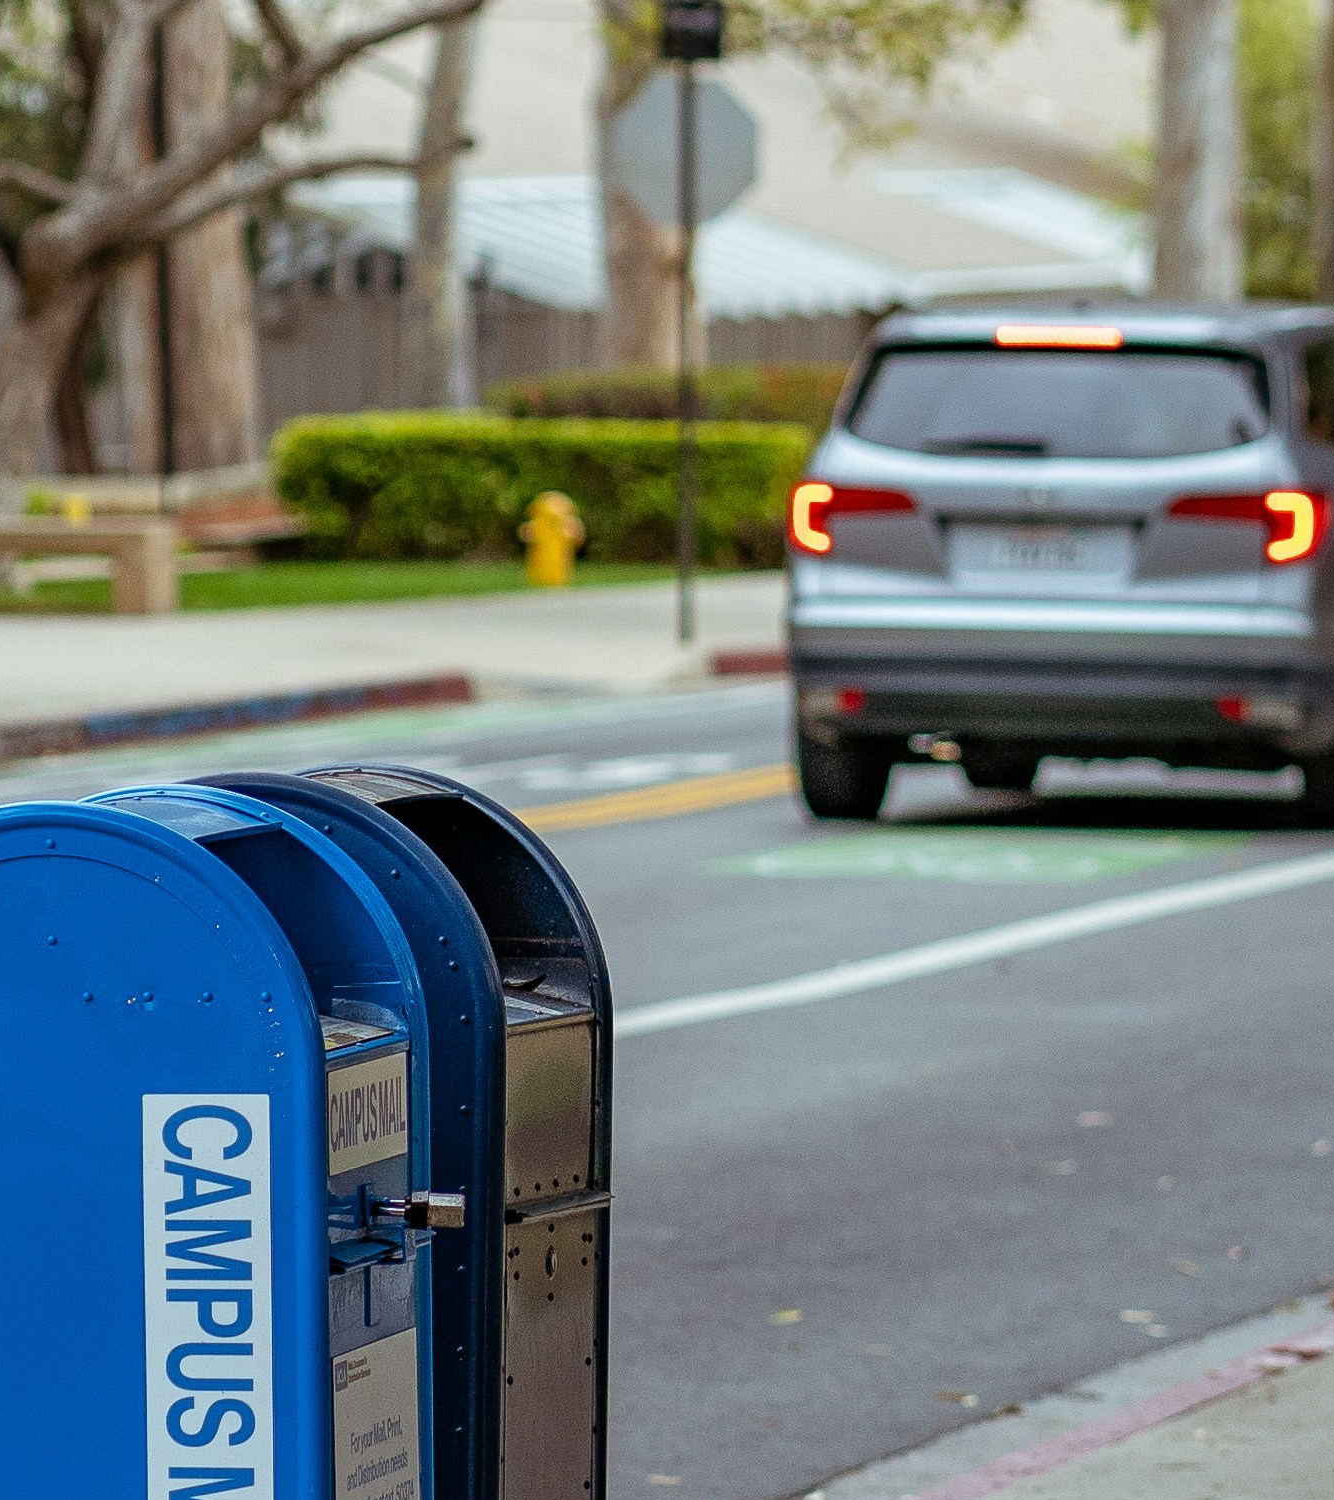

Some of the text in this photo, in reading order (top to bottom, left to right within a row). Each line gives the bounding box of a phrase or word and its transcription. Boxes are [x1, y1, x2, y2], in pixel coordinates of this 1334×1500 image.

[330, 1076, 406, 1153] CAMPUS MAIL
[161, 1104, 254, 1449] CAMPUS
[350, 1432, 359, 1455] For
[360, 1428, 373, 1456] your
[387, 1415, 403, 1440] Print,
[347, 1447, 408, 1491] and Distribution needs
